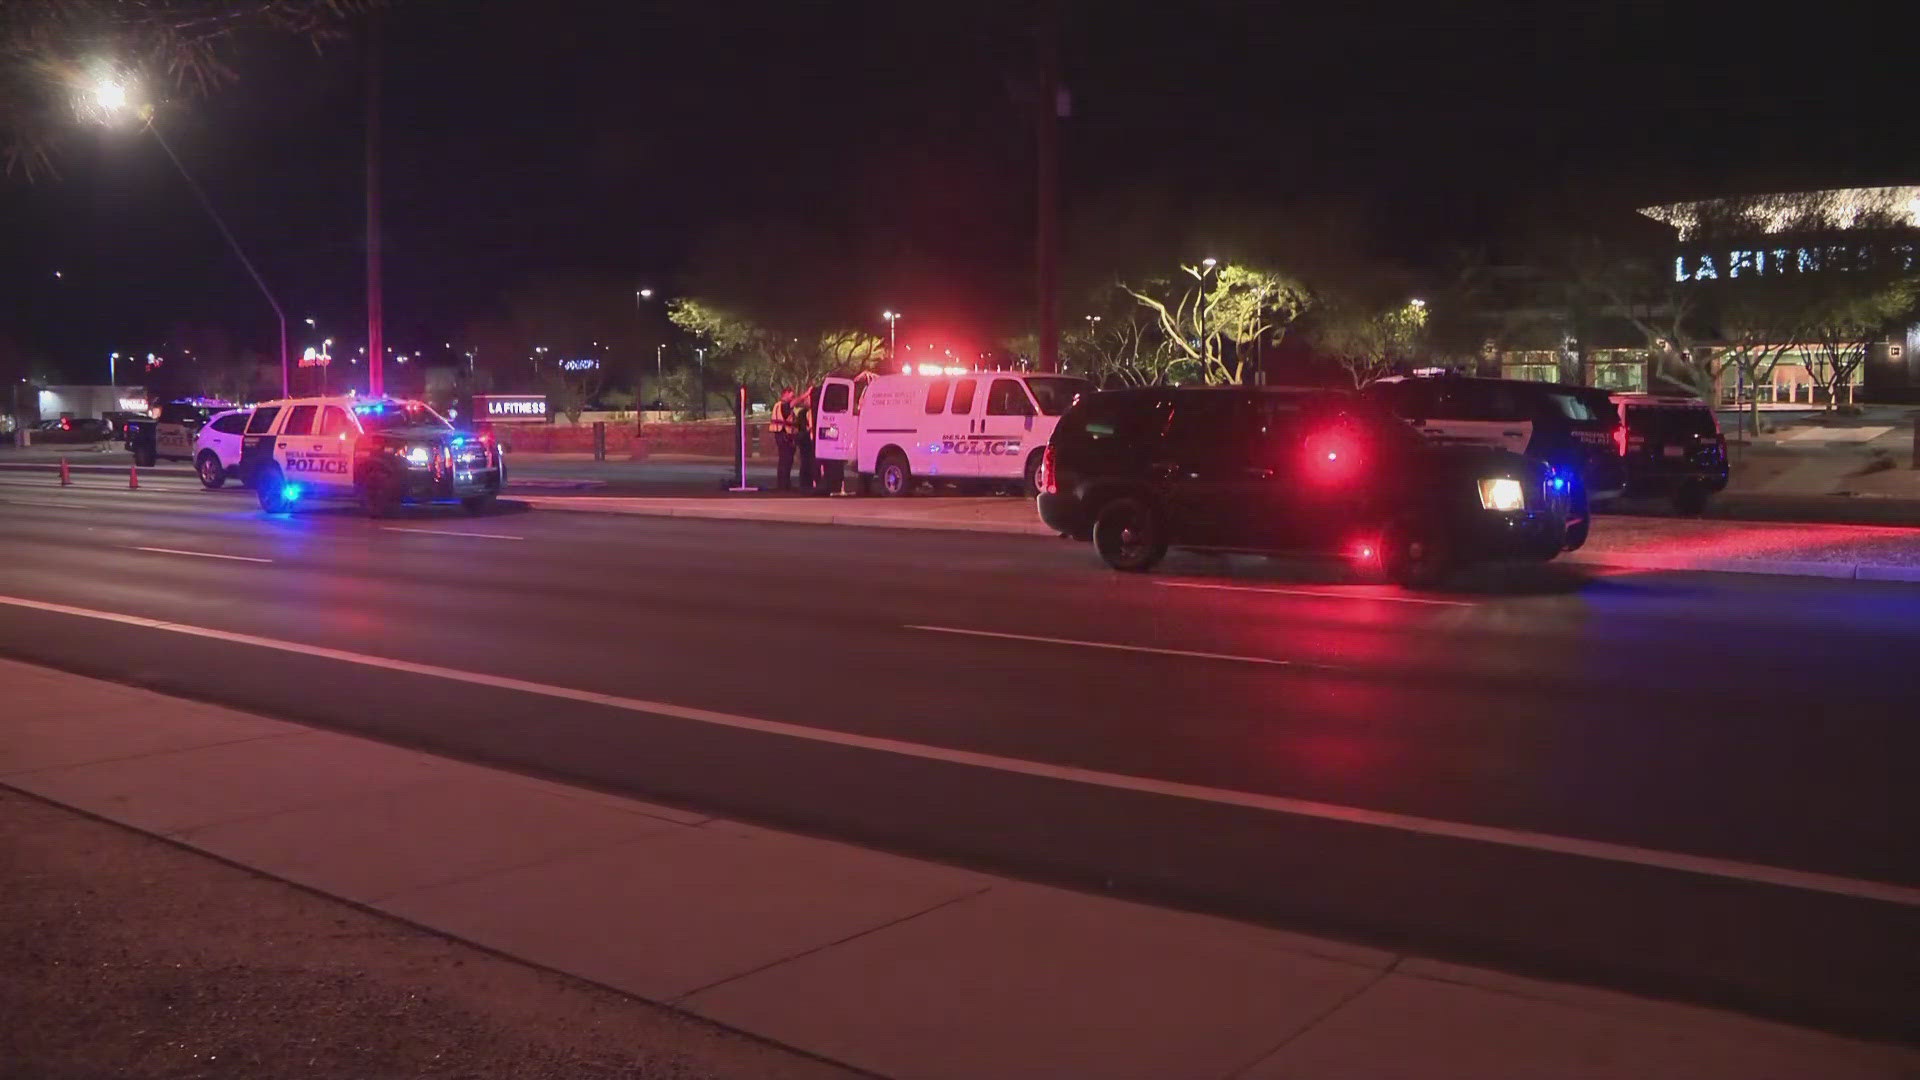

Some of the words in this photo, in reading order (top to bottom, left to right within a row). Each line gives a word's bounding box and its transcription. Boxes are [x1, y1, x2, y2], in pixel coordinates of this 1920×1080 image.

[1675, 254, 1718, 282] LA
[488, 402, 503, 415] LA
[503, 402, 546, 415] FITNESS
[940, 441, 1021, 456] POLICE
[286, 458, 348, 474] POLICE
